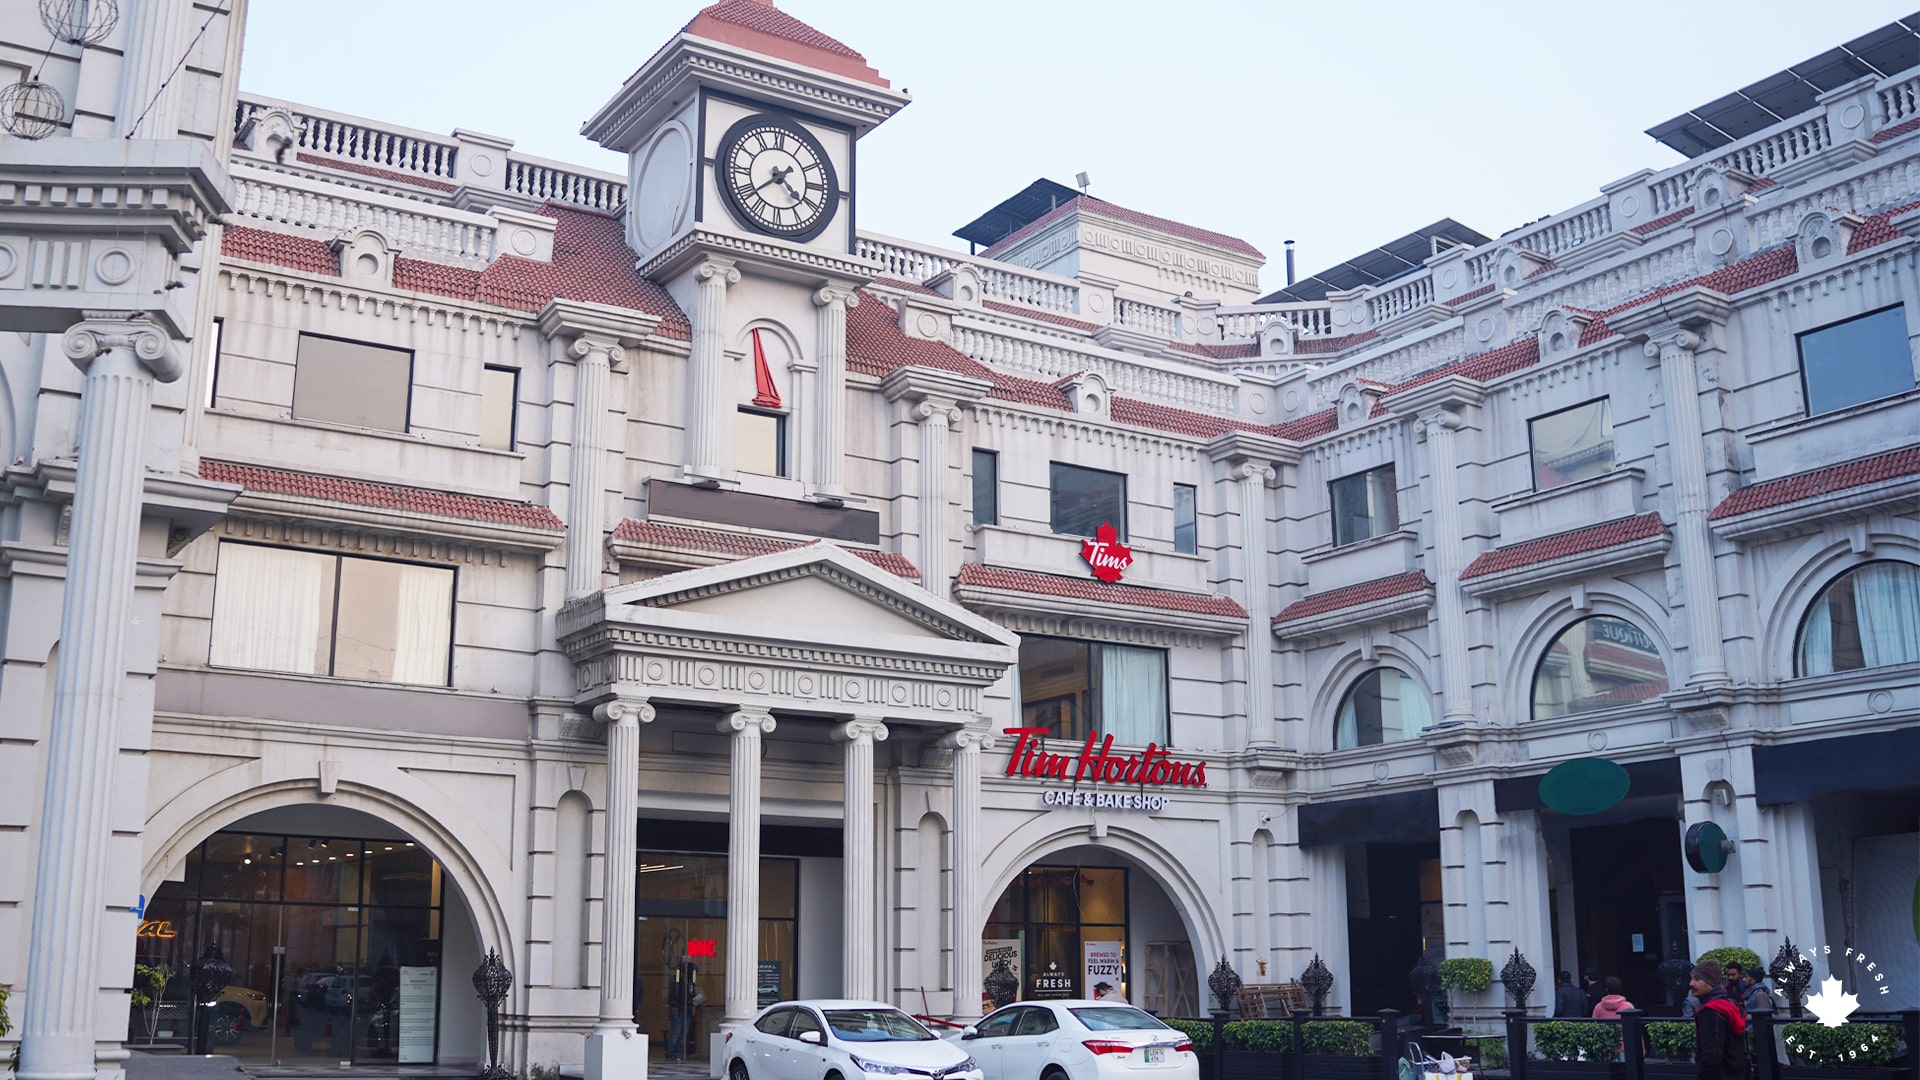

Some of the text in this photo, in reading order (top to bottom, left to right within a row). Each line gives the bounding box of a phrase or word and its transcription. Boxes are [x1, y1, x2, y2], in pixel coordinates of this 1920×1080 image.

[1087, 541, 1127, 570] Tims
[1003, 727, 1207, 788] Tim Hortons
[1044, 788, 1170, 811] CAFÉ & BAKE SHOP
[1088, 965, 1119, 975] FUZZY
[1036, 979, 1071, 988] FRESH
